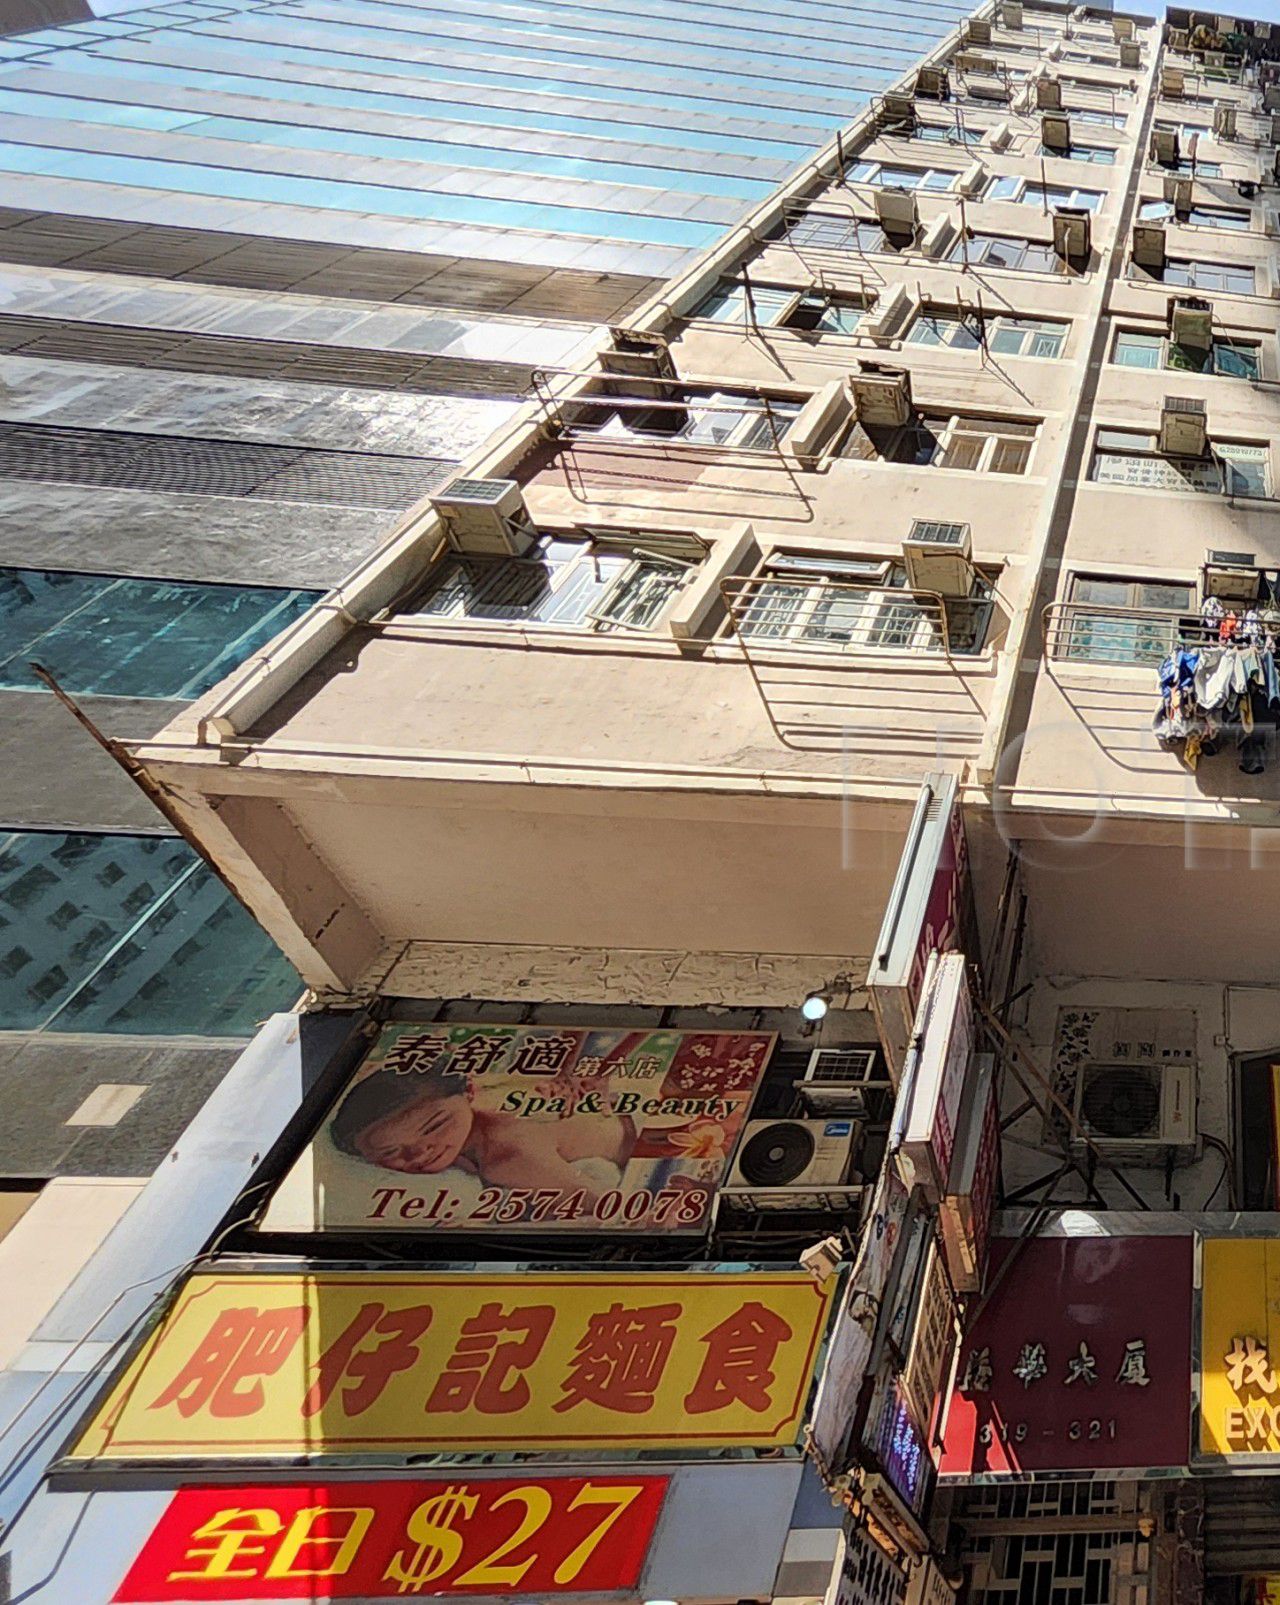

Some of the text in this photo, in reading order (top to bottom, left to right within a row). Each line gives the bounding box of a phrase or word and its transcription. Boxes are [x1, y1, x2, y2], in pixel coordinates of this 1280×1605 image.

[384, 1034, 576, 1077] 泰舒適
[500, 1089, 743, 1121] Spa & Beauty
[367, 1187, 708, 1223] Tel: 2574 0078
[149, 1301, 794, 1418] 肥仔記麵食
[169, 1485, 642, 1593] 全日 $27
